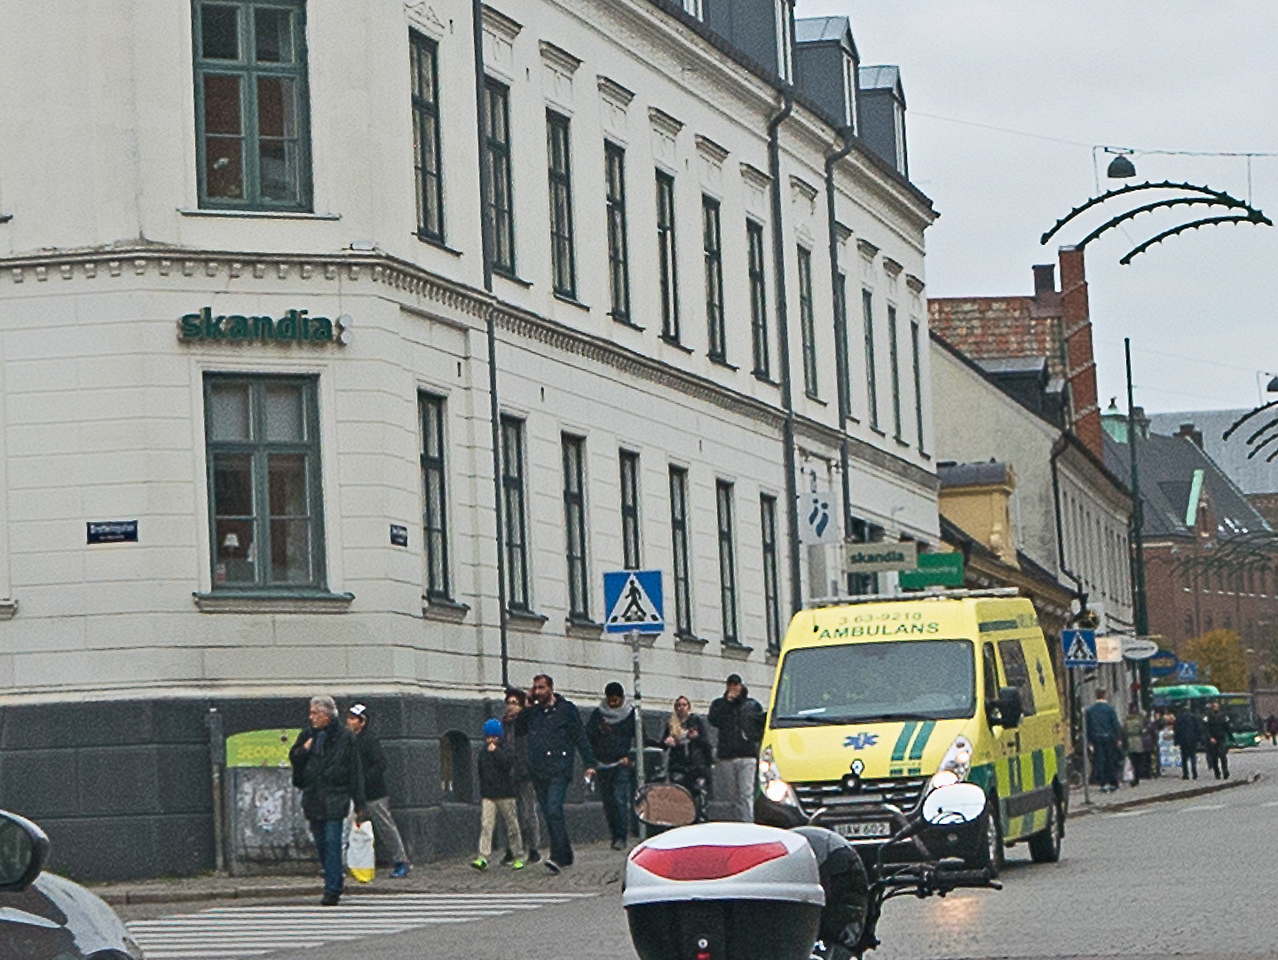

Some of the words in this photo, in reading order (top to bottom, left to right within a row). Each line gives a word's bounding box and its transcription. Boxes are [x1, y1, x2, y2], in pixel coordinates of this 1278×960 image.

[181, 306, 334, 341] skandia
[850, 550, 905, 564] skandia
[818, 621, 940, 640] AMBULANS
